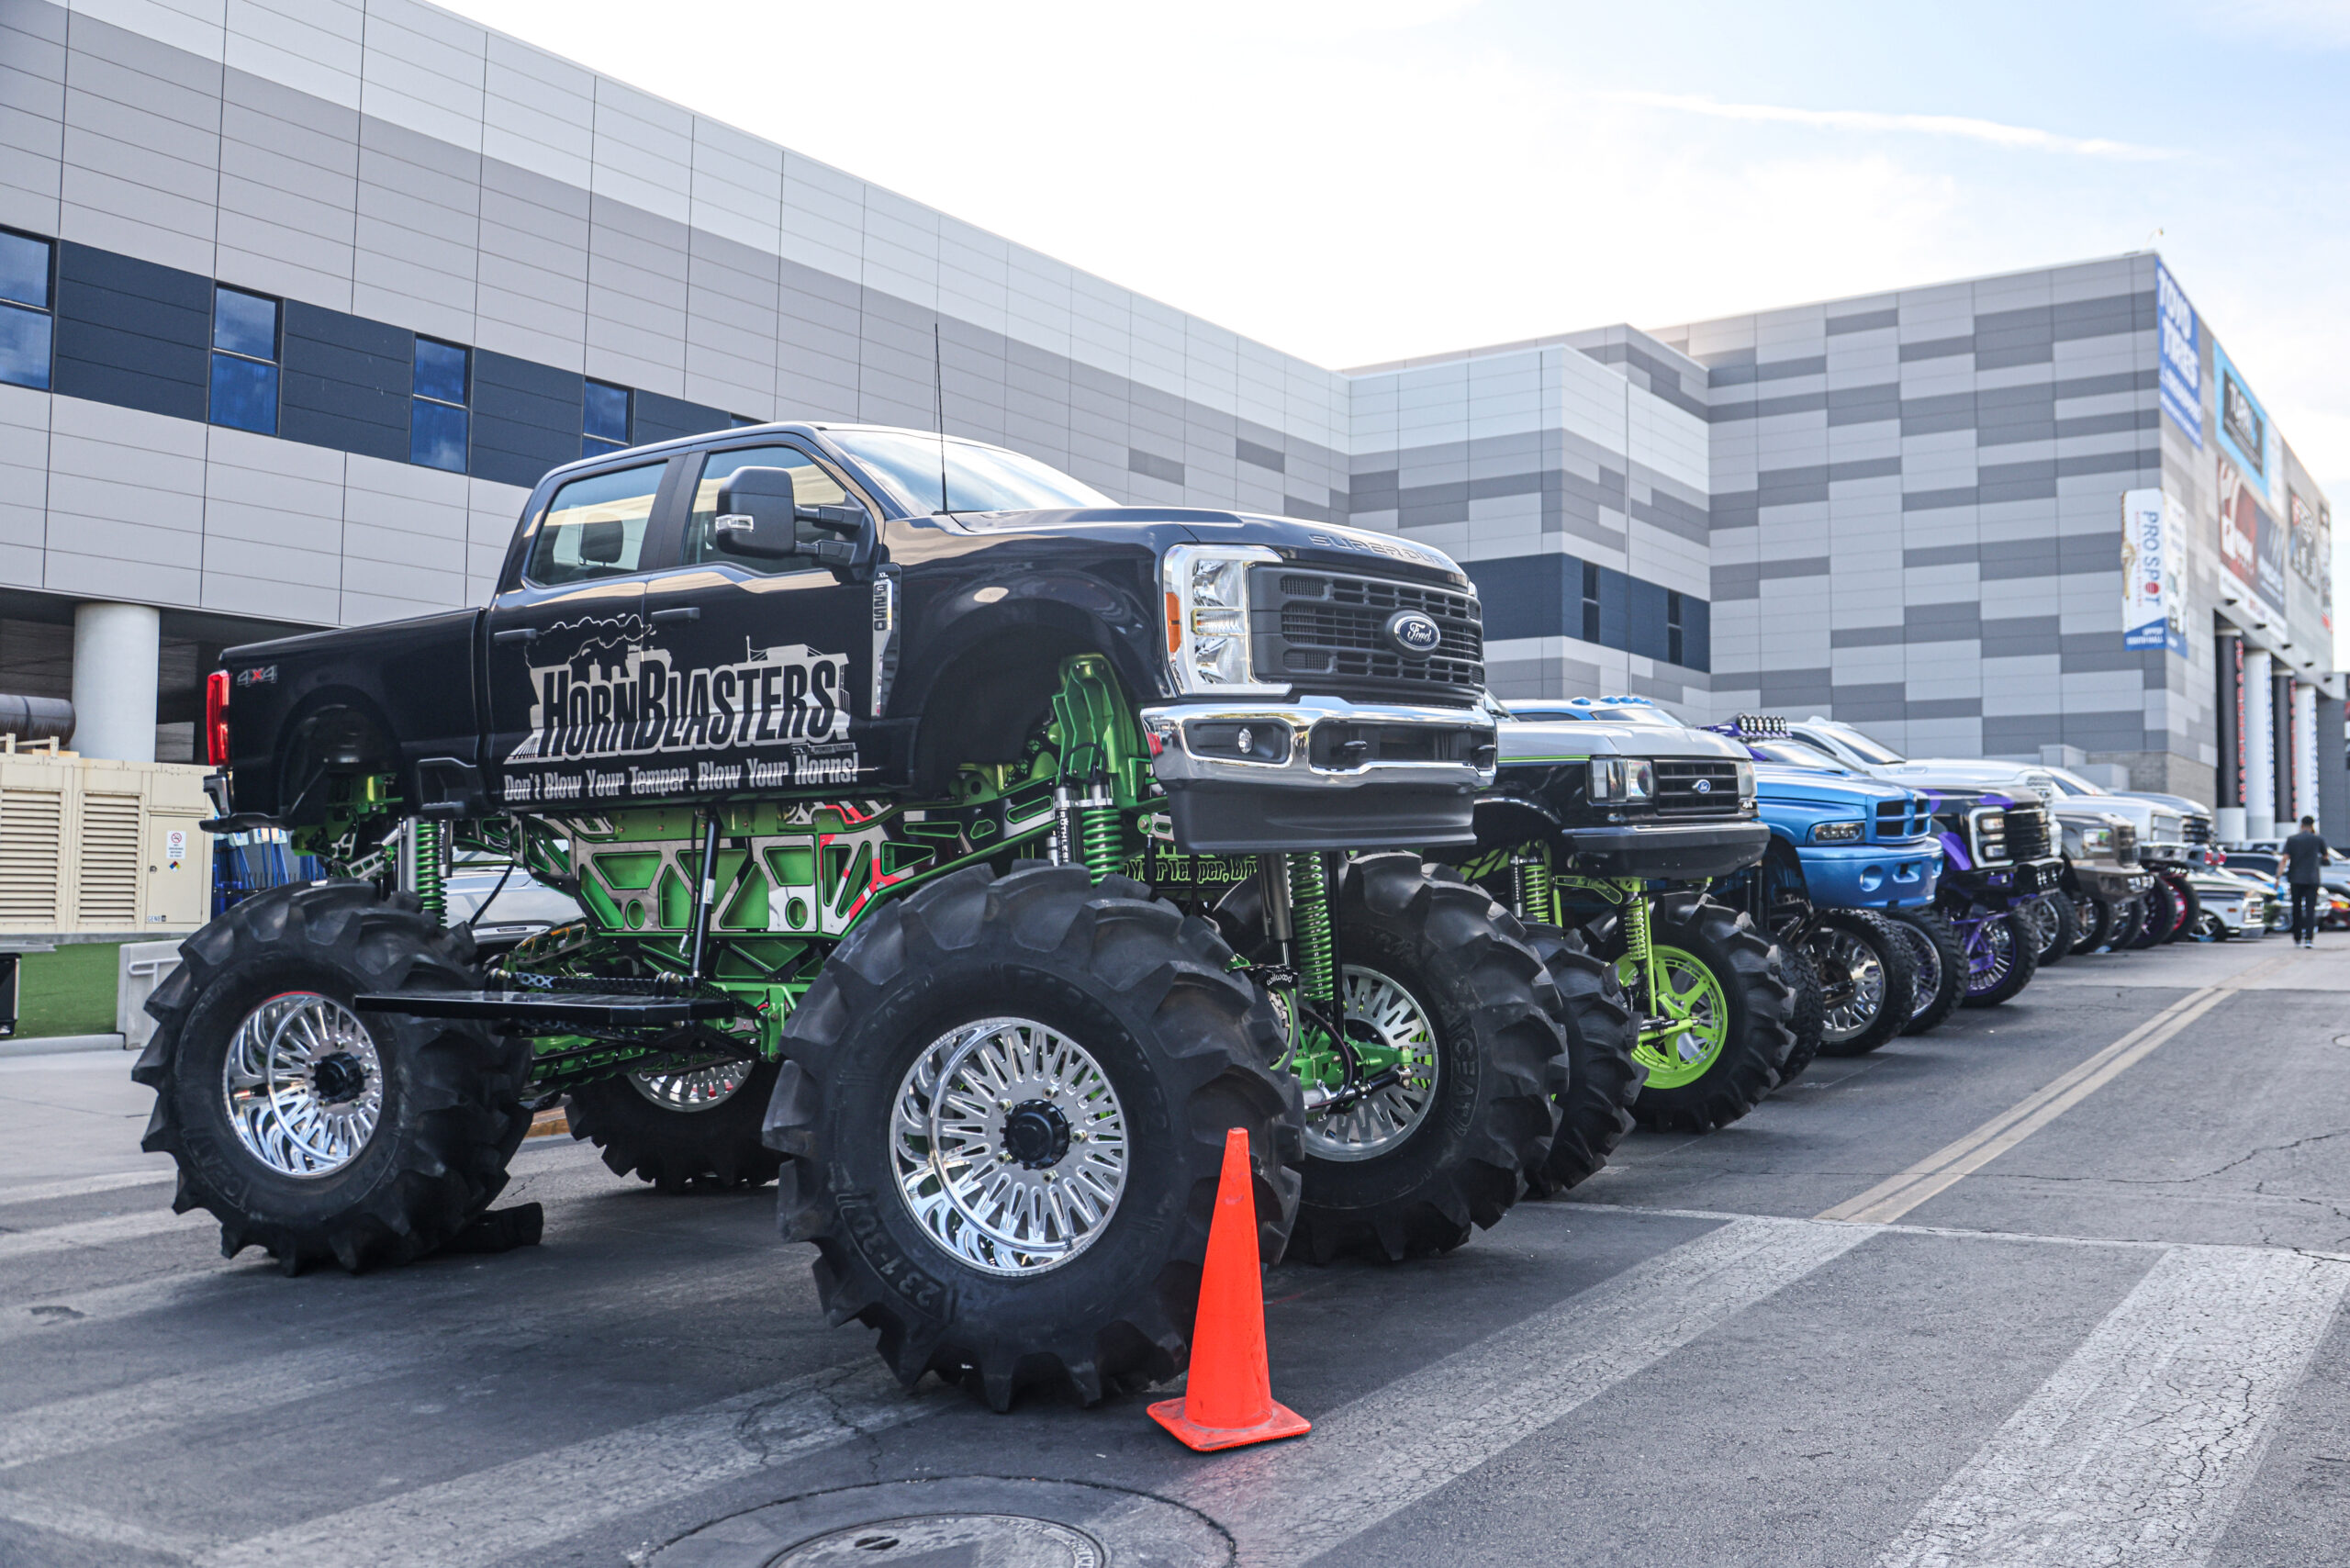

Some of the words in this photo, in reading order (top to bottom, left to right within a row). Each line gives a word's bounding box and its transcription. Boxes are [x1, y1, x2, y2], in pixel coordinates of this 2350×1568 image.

[2143, 510, 2159, 551] PRO
[1407, 622, 1432, 643] Ford
[504, 773, 541, 801] Don't
[543, 772, 582, 801] Blow
[586, 769, 625, 798] Your
[698, 761, 742, 791] Blow
[746, 758, 789, 788] Your
[794, 752, 859, 786] Horns!
[1168, 858, 1229, 884] Teper,
[1266, 972, 1292, 986] wilwood
